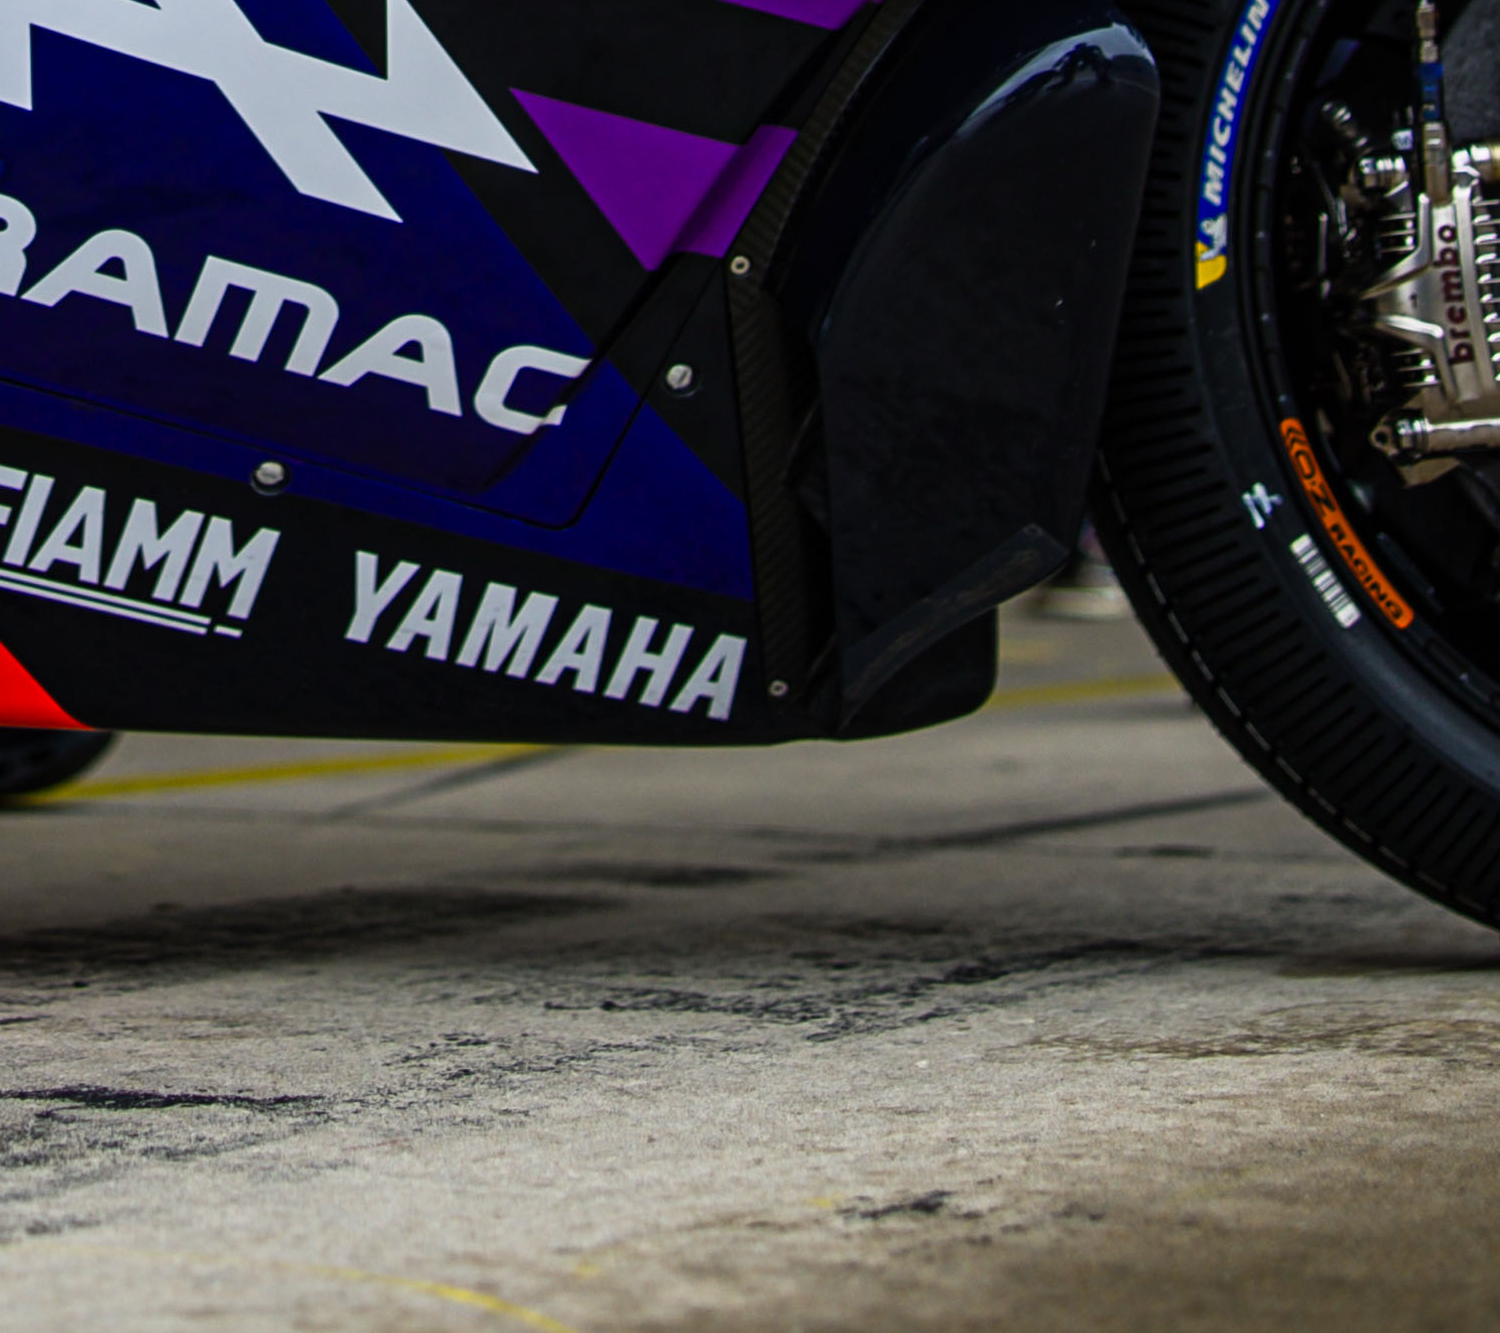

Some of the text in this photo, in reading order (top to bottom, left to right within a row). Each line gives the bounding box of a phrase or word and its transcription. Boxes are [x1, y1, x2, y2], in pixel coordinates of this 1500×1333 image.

[1433, 225, 1475, 364] brembo
[344, 550, 747, 721] YAMAHA
[1331, 524, 1402, 620] RACING
